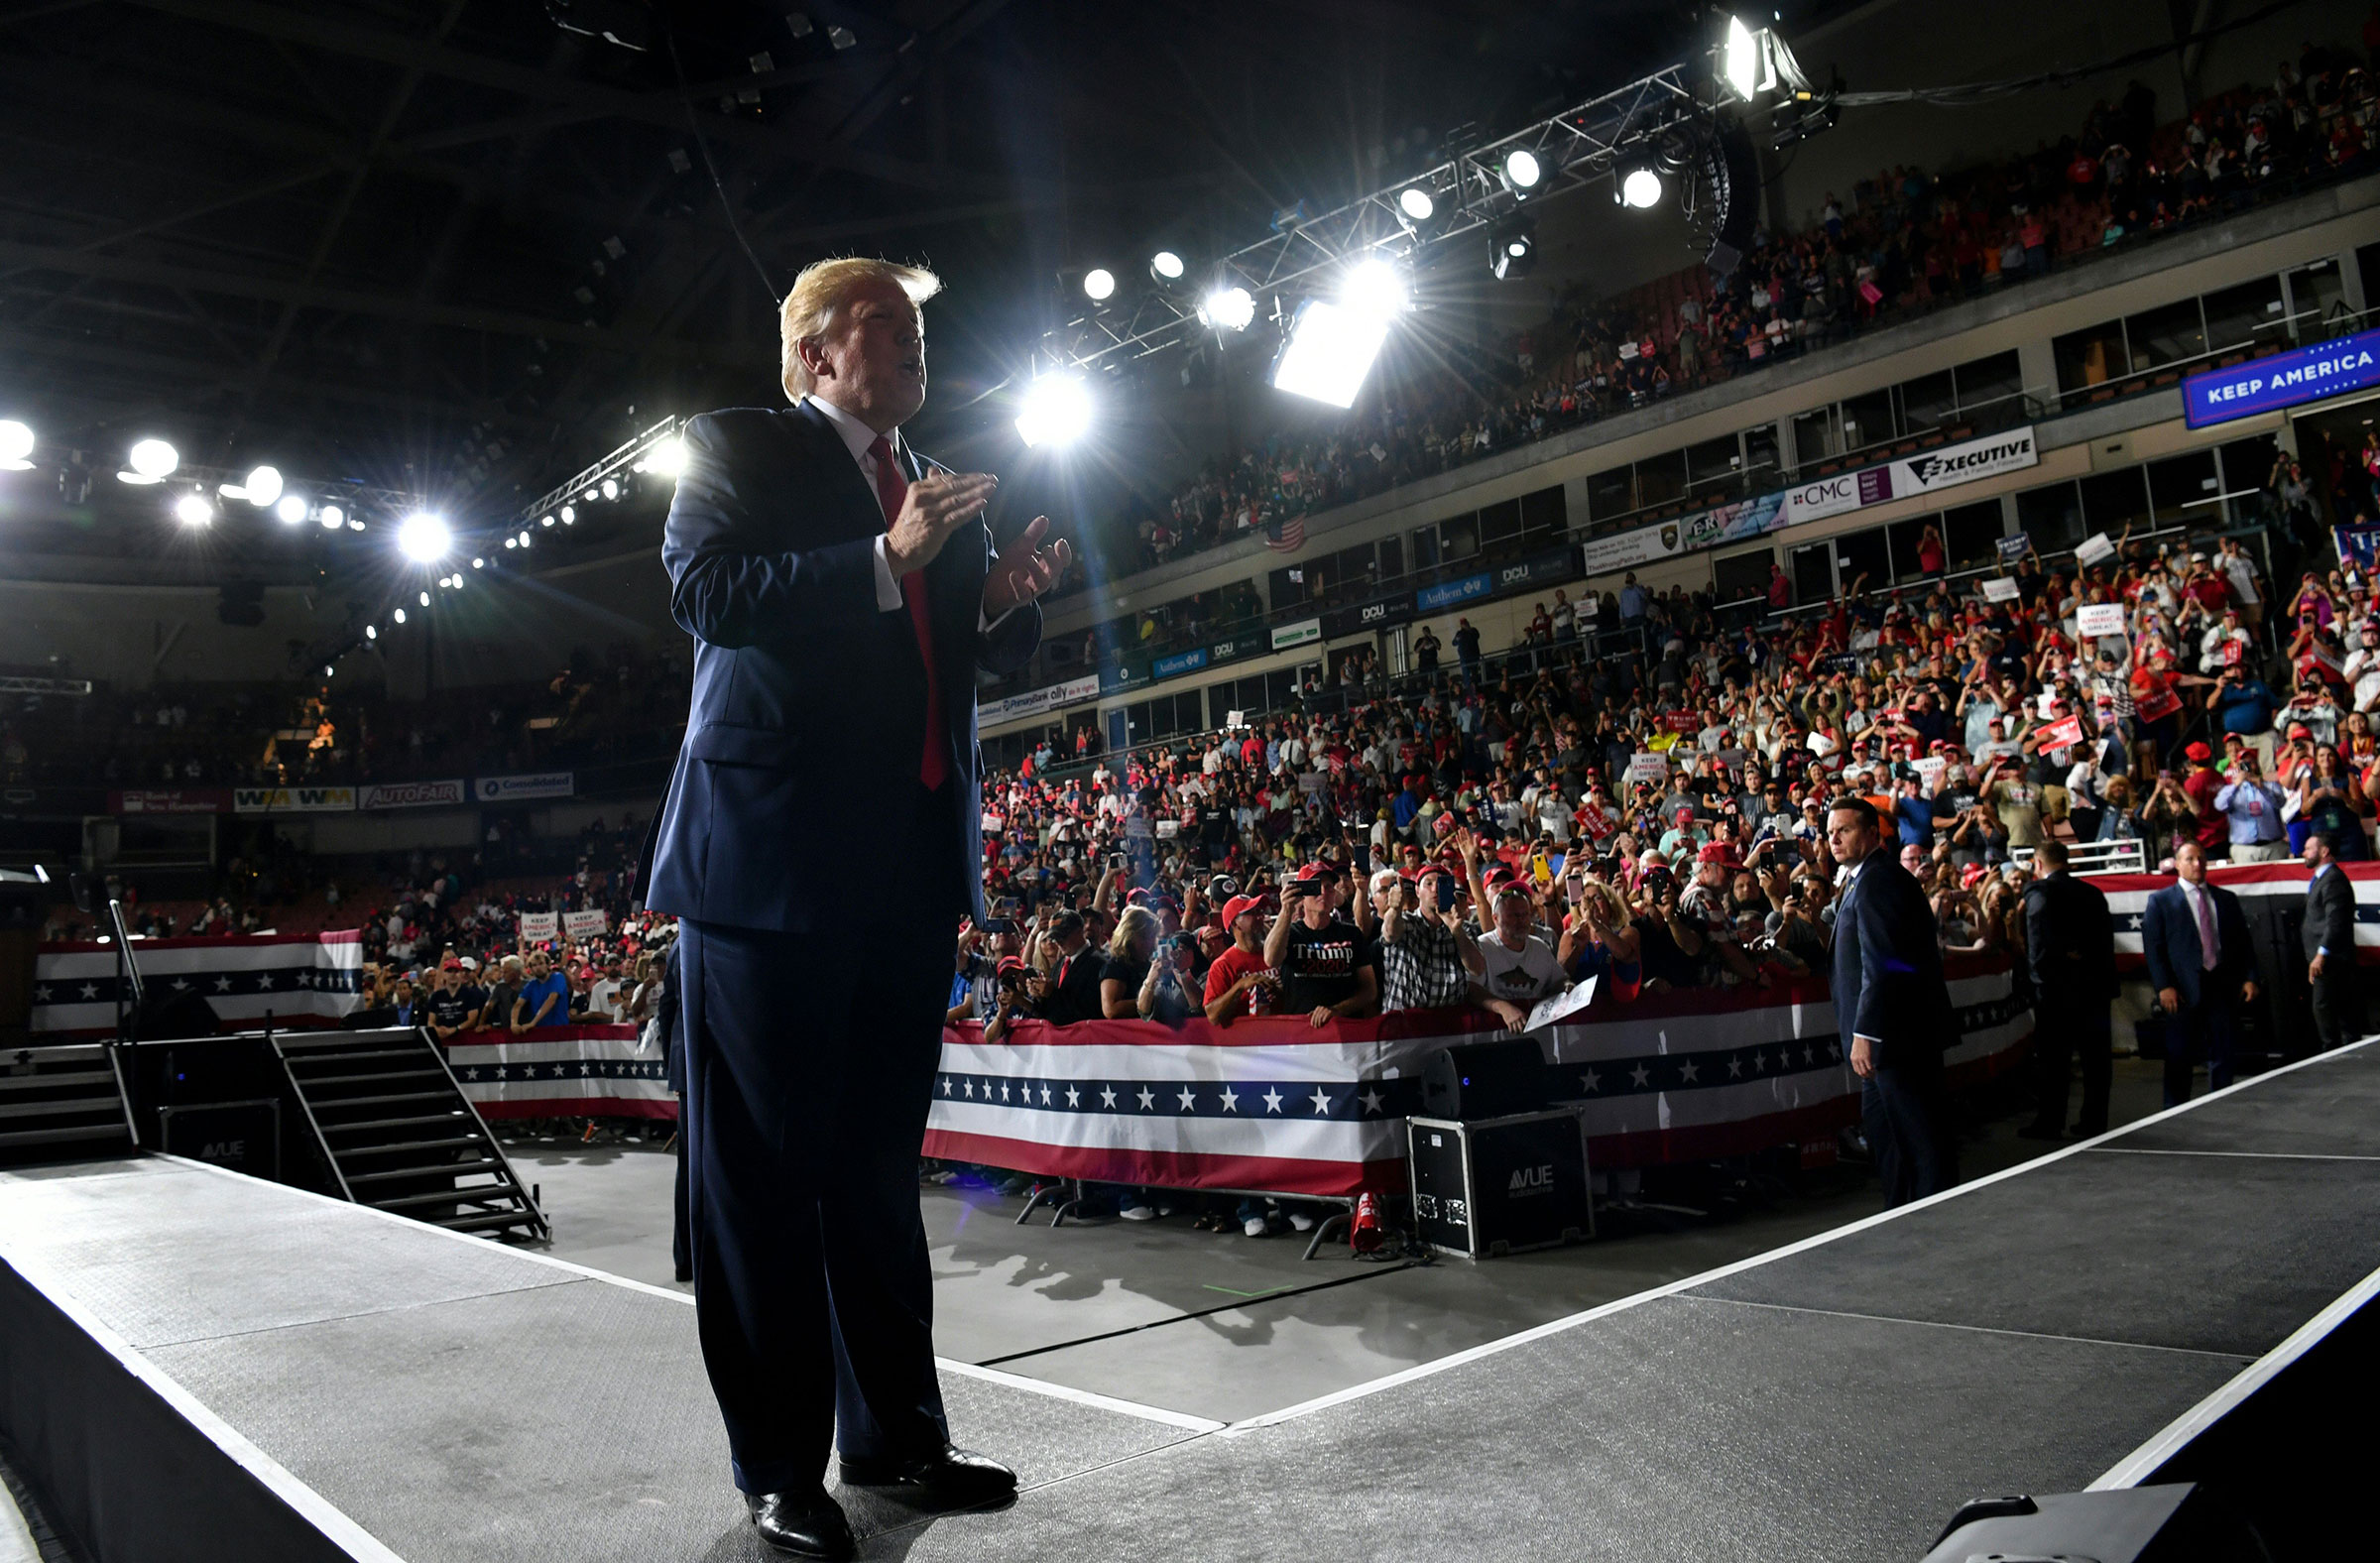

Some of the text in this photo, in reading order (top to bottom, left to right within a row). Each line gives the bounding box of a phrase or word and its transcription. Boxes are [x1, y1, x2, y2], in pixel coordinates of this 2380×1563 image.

[2207, 350, 2374, 405] KEEP AMERICA
[1805, 477, 1851, 505] CMC
[1502, 564, 1529, 582] DCU
[1425, 587, 1462, 605] Anthem
[1362, 603, 1384, 620] DCU
[2082, 615, 2122, 625] AMERICA
[1214, 642, 1234, 657] DCU
[1158, 659, 1186, 672] Anthem
[1050, 685, 1067, 700] ally
[503, 776, 569, 789] Consolidated
[298, 789, 351, 805] WM
[1585, 806, 1607, 833] TRUMP
[567, 918, 603, 929] AMERICA
